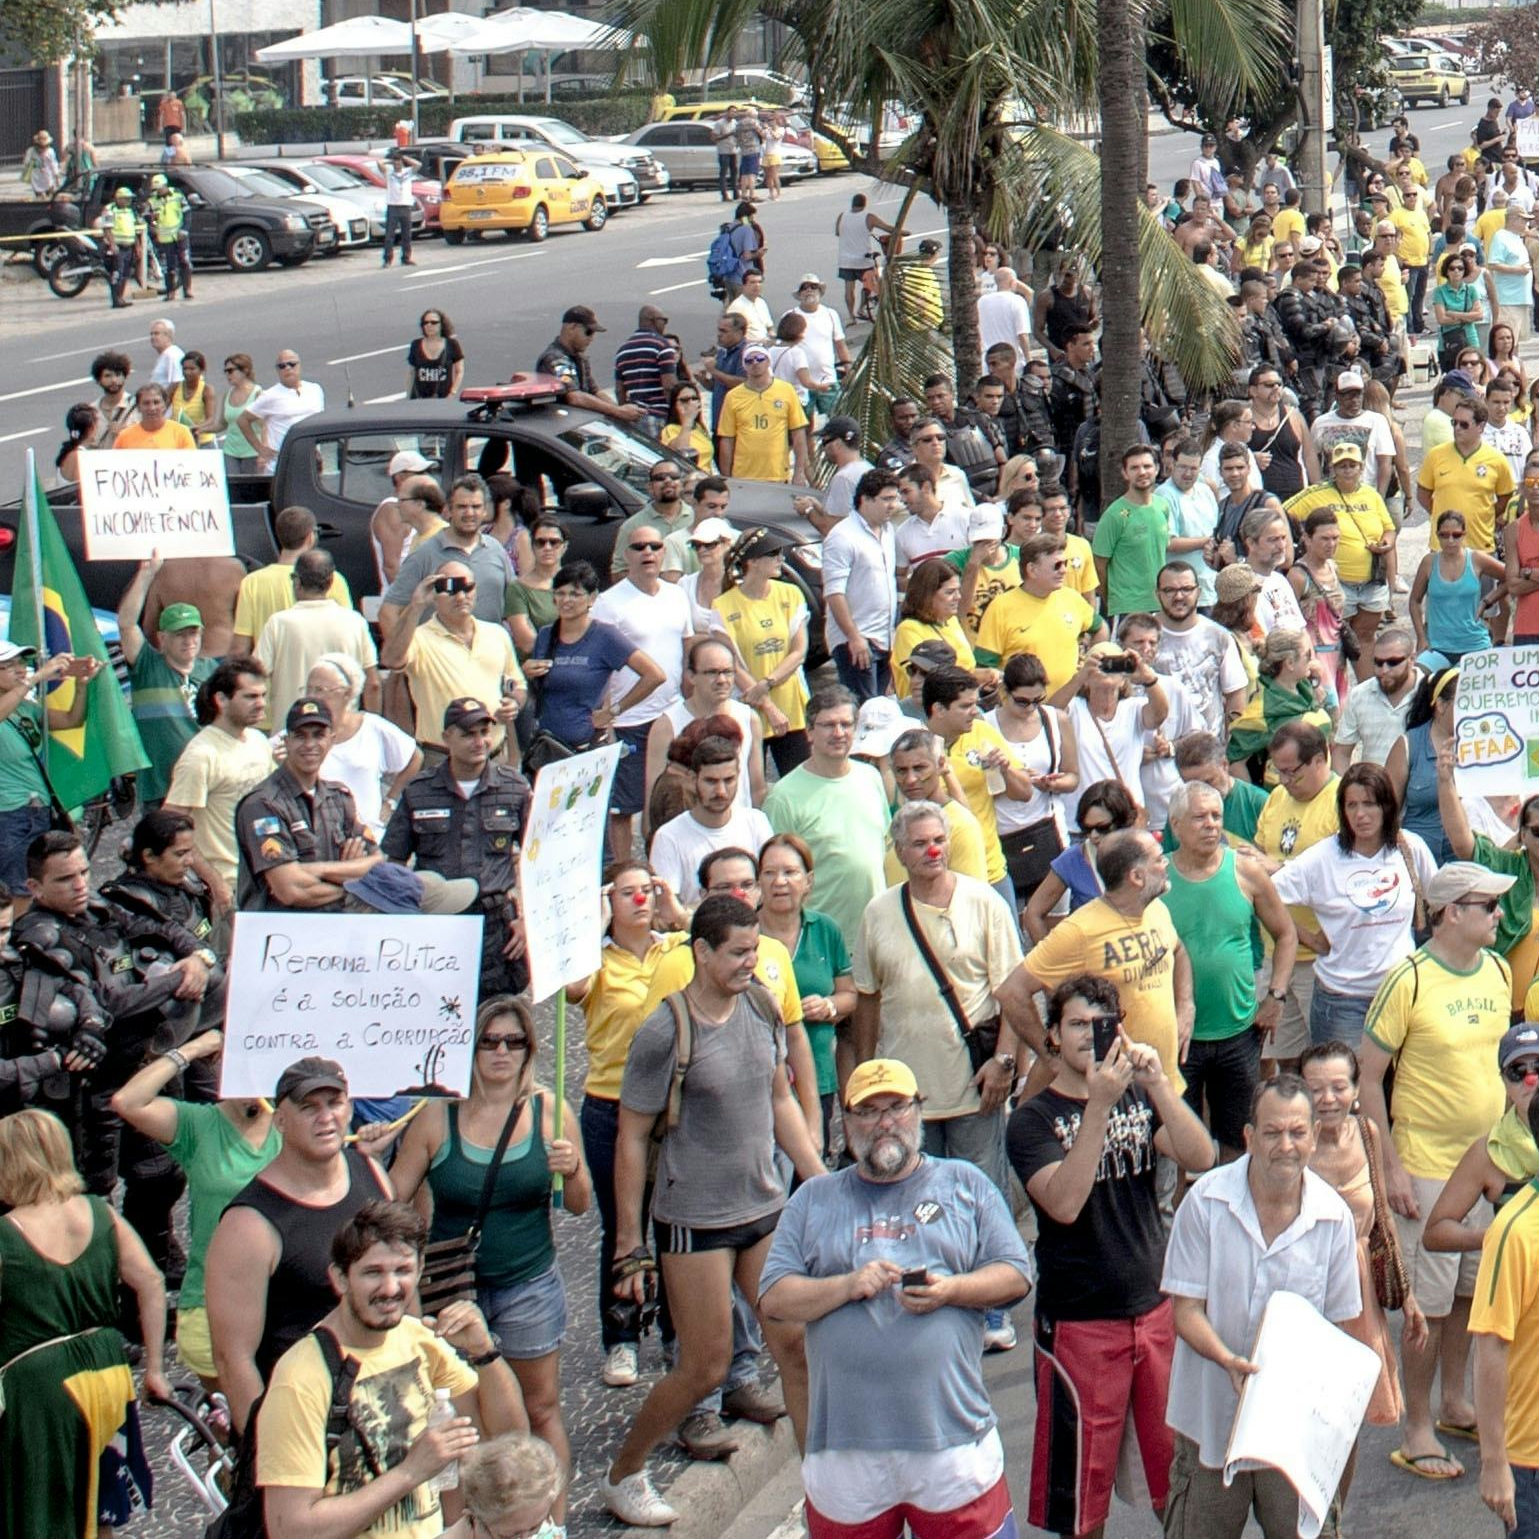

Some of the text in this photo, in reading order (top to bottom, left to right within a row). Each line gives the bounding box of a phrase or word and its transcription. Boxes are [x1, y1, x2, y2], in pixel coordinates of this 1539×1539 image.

[491, 166, 517, 178] FM
[754, 413, 769, 430] 16
[94, 460, 160, 498] FORA!
[93, 506, 219, 536] INCOMPETÊNCIA
[1463, 653, 1499, 673] POR
[1460, 674, 1497, 693] SEM
[1459, 734, 1518, 763] FFAA
[298, 993, 316, 1011] a
[1447, 995, 1498, 1017] BRASIL
[336, 1032, 355, 1050] a
